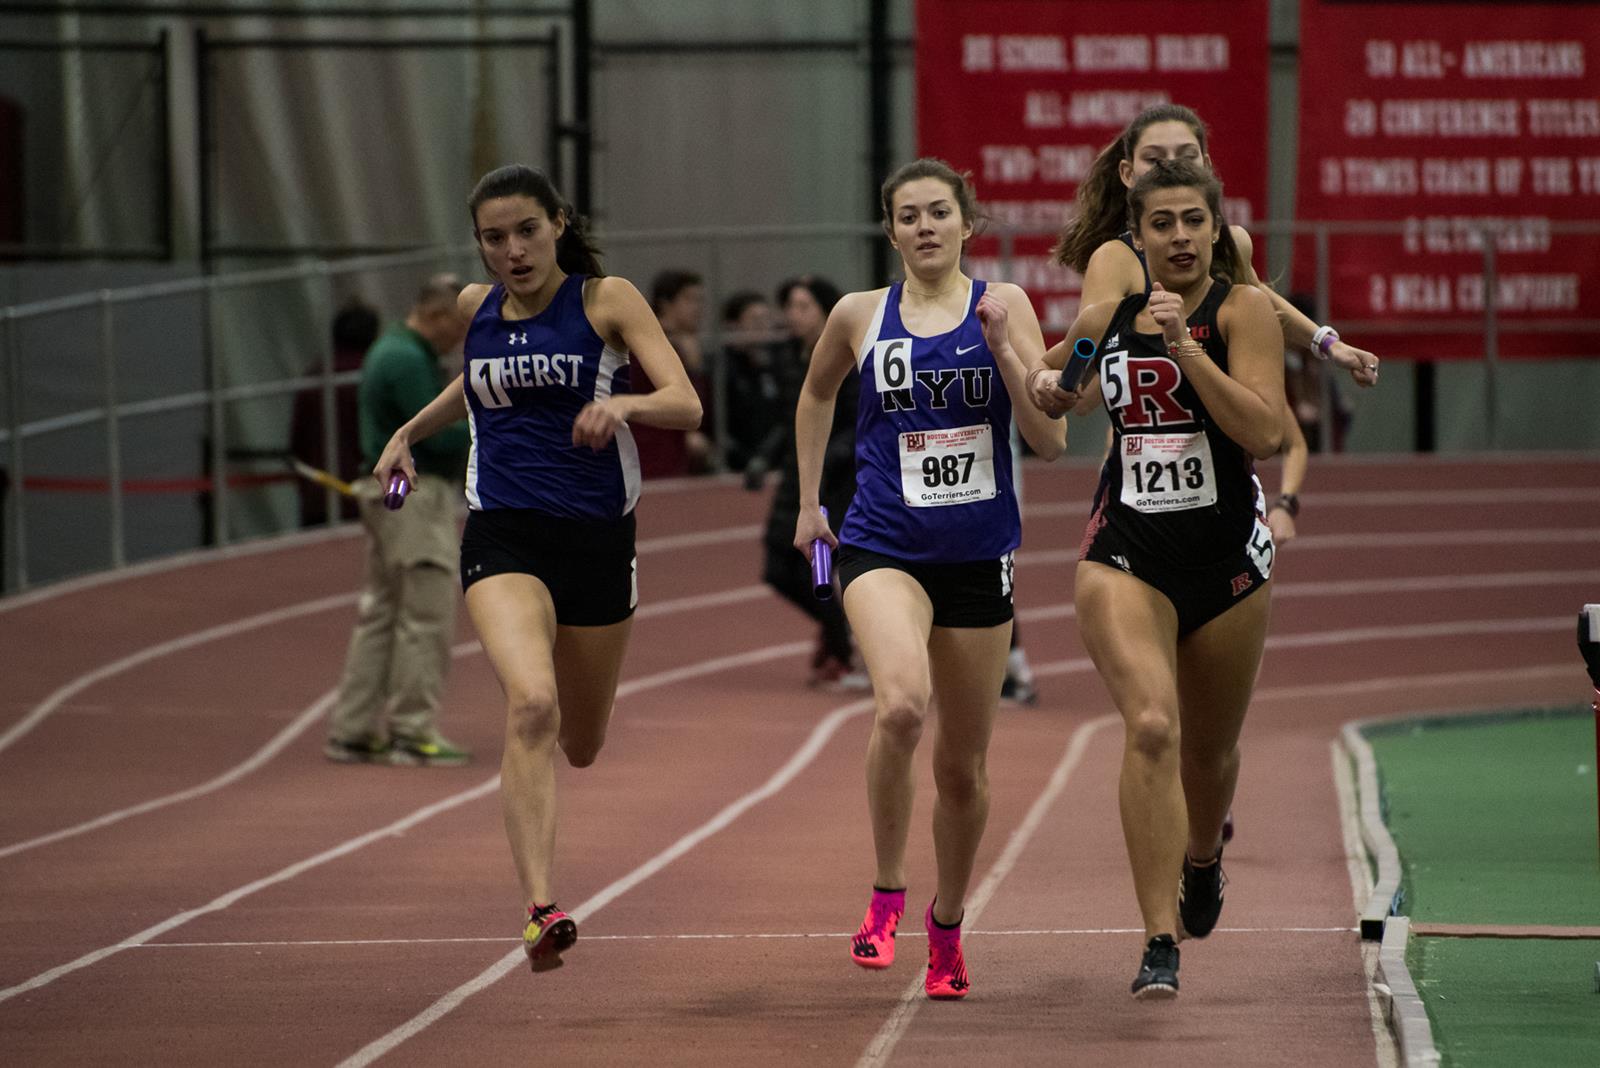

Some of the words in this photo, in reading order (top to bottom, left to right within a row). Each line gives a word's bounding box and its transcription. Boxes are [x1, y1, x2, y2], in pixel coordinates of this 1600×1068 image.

[1463, 40, 1584, 78] AMERICANS
[1382, 100, 1520, 136] CONFERENCE
[1422, 157, 1490, 195] COACH
[1495, 157, 1523, 195] OF
[1531, 157, 1571, 195] THE
[1457, 274, 1580, 310] CHMPIONS
[883, 341, 906, 389] 6
[1104, 355, 1123, 407] 5
[1119, 356, 1196, 429] R
[921, 452, 976, 488] 987
[1131, 456, 1204, 494] 1213
[921, 488, 982, 501] GoTerriers.com
[1136, 495, 1200, 507] GoTerriers.com
